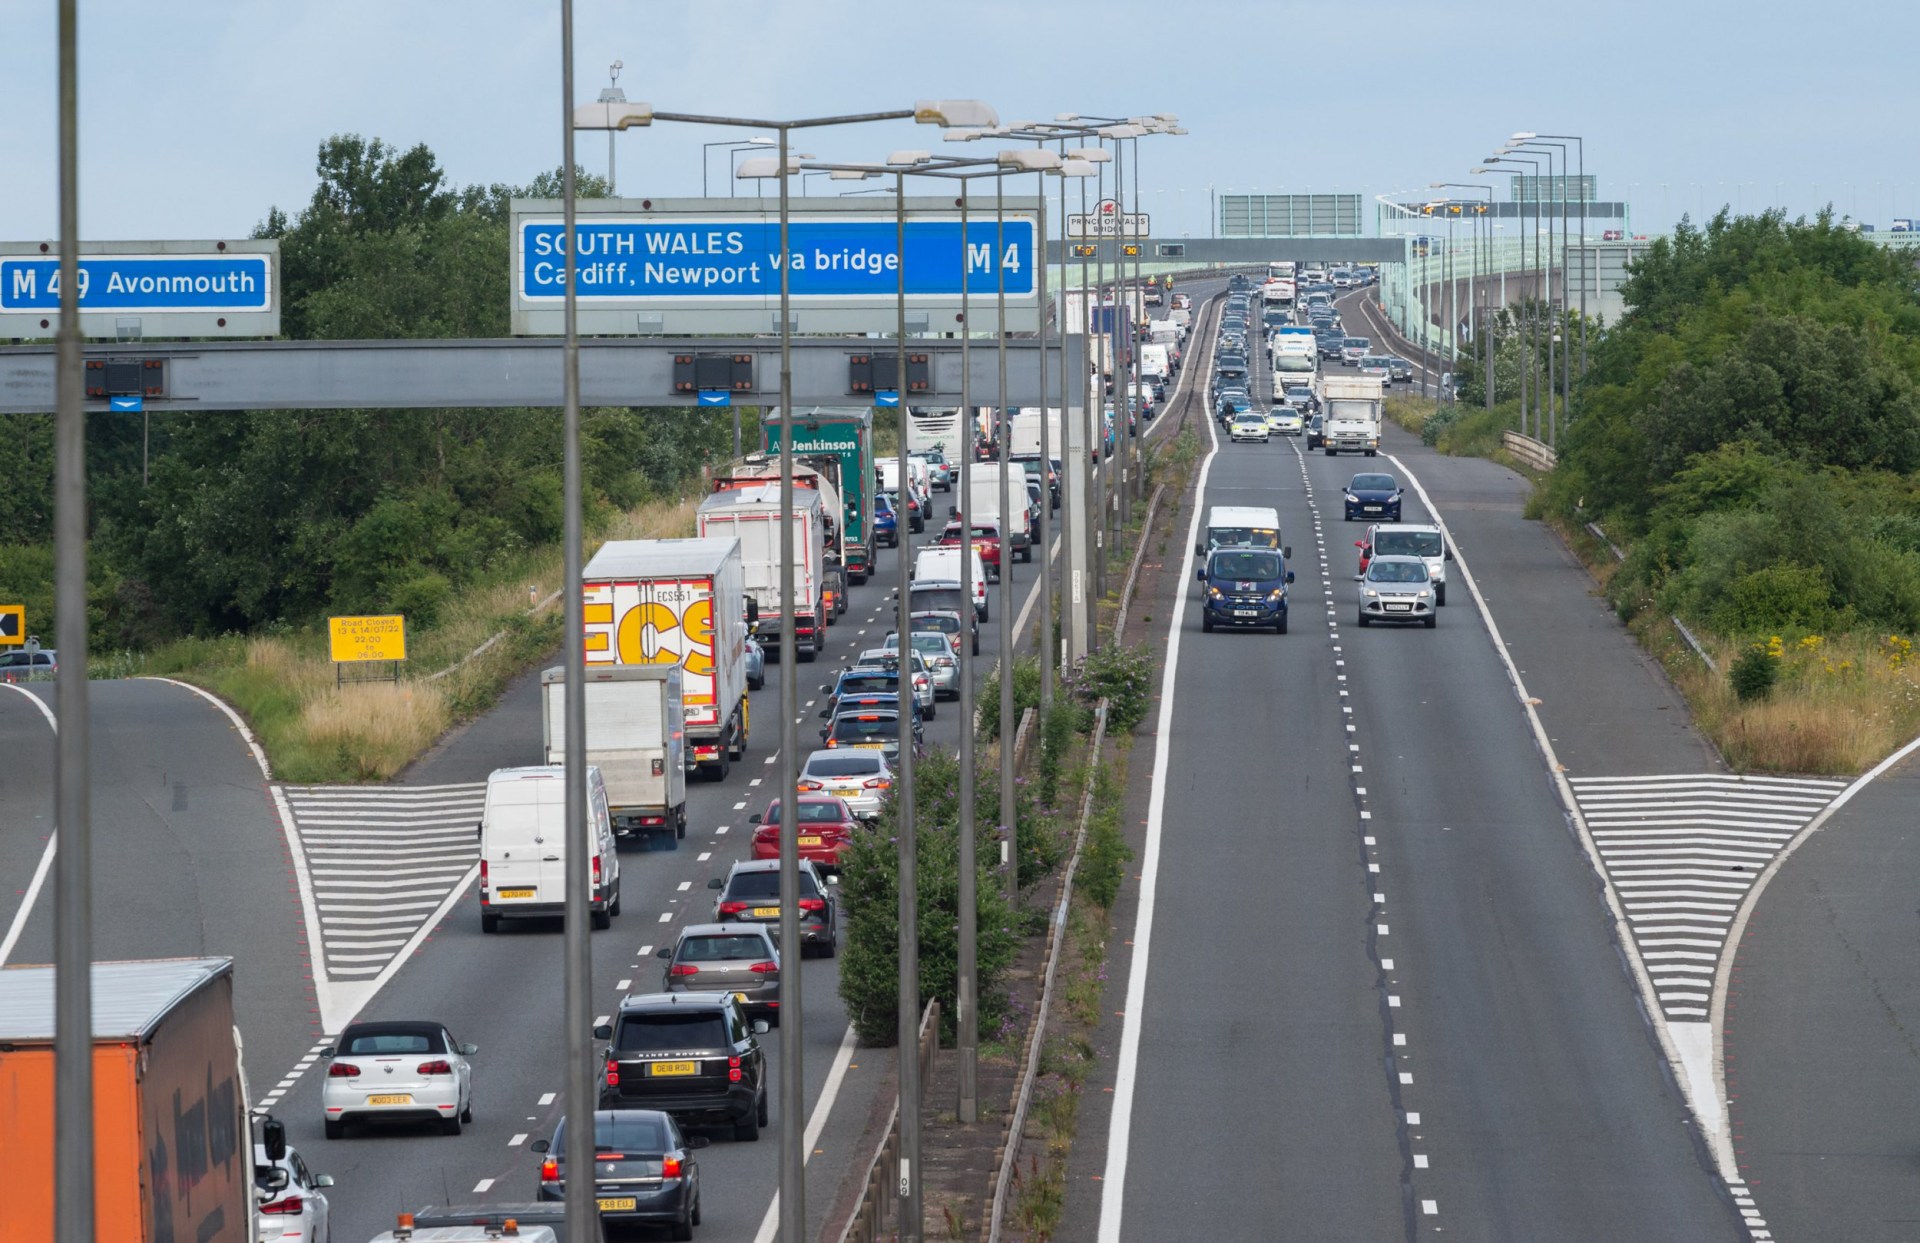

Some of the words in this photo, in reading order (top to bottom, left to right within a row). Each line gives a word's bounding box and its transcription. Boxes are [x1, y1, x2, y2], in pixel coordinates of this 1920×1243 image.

[534, 232, 635, 256] SOUTH
[645, 231, 744, 255] WALES
[1126, 247, 1137, 255] 30
[815, 249, 899, 275] bridge
[967, 243, 991, 274] M
[1002, 243, 1020, 274] 4
[13, 269, 36, 299] M
[47, 269, 89, 299] 49
[106, 271, 255, 293] Avonmouth
[645, 262, 760, 287] Newport
[791, 439, 856, 452] Jenkinson
